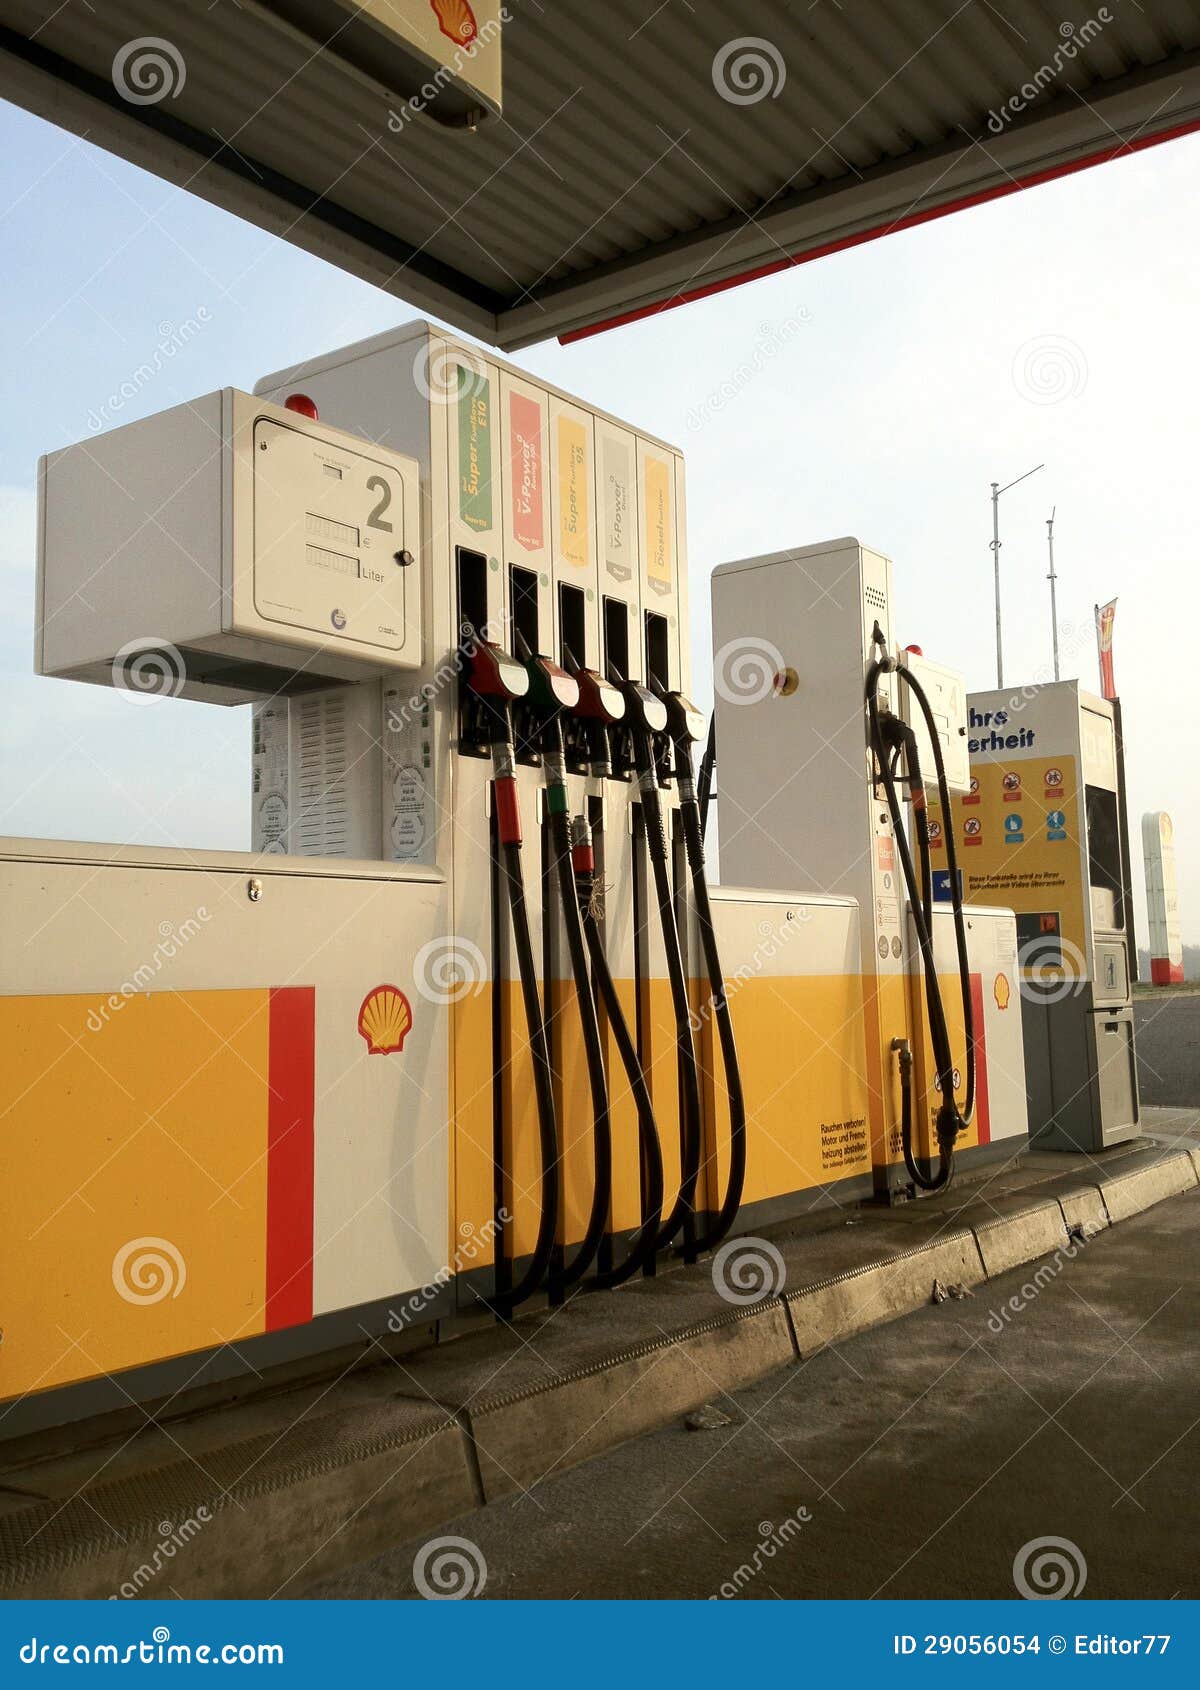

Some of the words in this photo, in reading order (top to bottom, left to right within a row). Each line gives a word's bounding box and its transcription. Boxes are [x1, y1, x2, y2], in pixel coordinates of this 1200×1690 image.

[478, 400, 488, 427] E10
[576, 447, 584, 464] 95
[468, 443, 480, 496] Super
[522, 440, 532, 514] V-Power
[366, 475, 393, 533] 2
[568, 488, 579, 533] Super
[613, 480, 623, 549] V-Power
[362, 537, 372, 549] €
[657, 525, 665, 567] Diesel
[362, 567, 385, 583] Liter
[969, 707, 1008, 728] hre
[968, 727, 1035, 753] erheit
[1011, 881, 1029, 889] Video
[820, 1122, 843, 1134] Rauchen
[843, 1116, 866, 1130] verboten!
[821, 1136, 838, 1147] Motor
[838, 1132, 849, 1143] und
[821, 1148, 843, 1160] heizung
